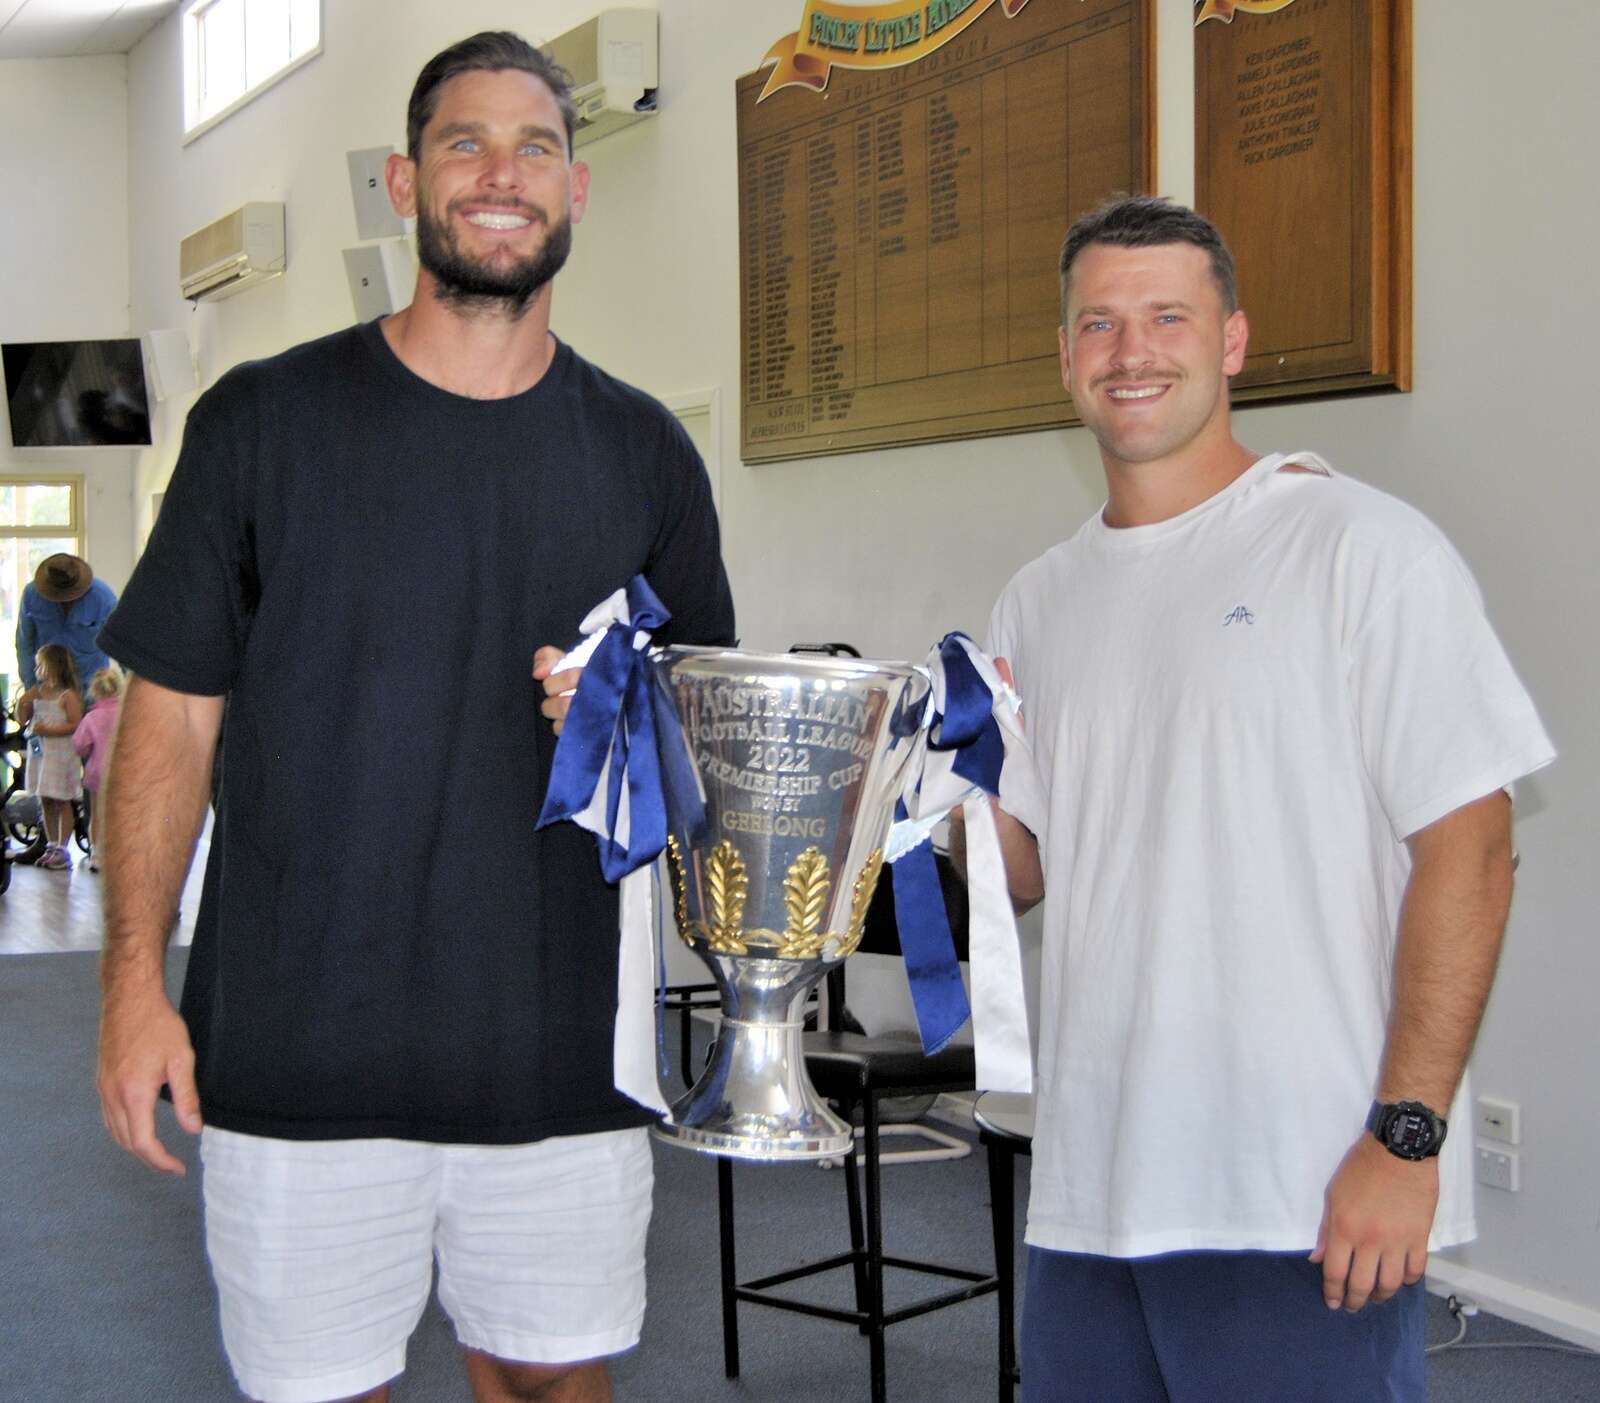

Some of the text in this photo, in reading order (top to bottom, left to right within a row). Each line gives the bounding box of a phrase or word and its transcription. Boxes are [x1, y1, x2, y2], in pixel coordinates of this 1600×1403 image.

[810, 11, 863, 51] FINLEY
[864, 9, 921, 51] LITTLE
[890, 65, 910, 87] OF
[701, 686, 874, 734] AUSTRALIAN
[746, 745, 811, 773] 2022
[796, 723, 873, 759] LEAGUE
[697, 749, 863, 796] PREMIERSHIP CUP
[721, 810, 826, 838] GEELONG
